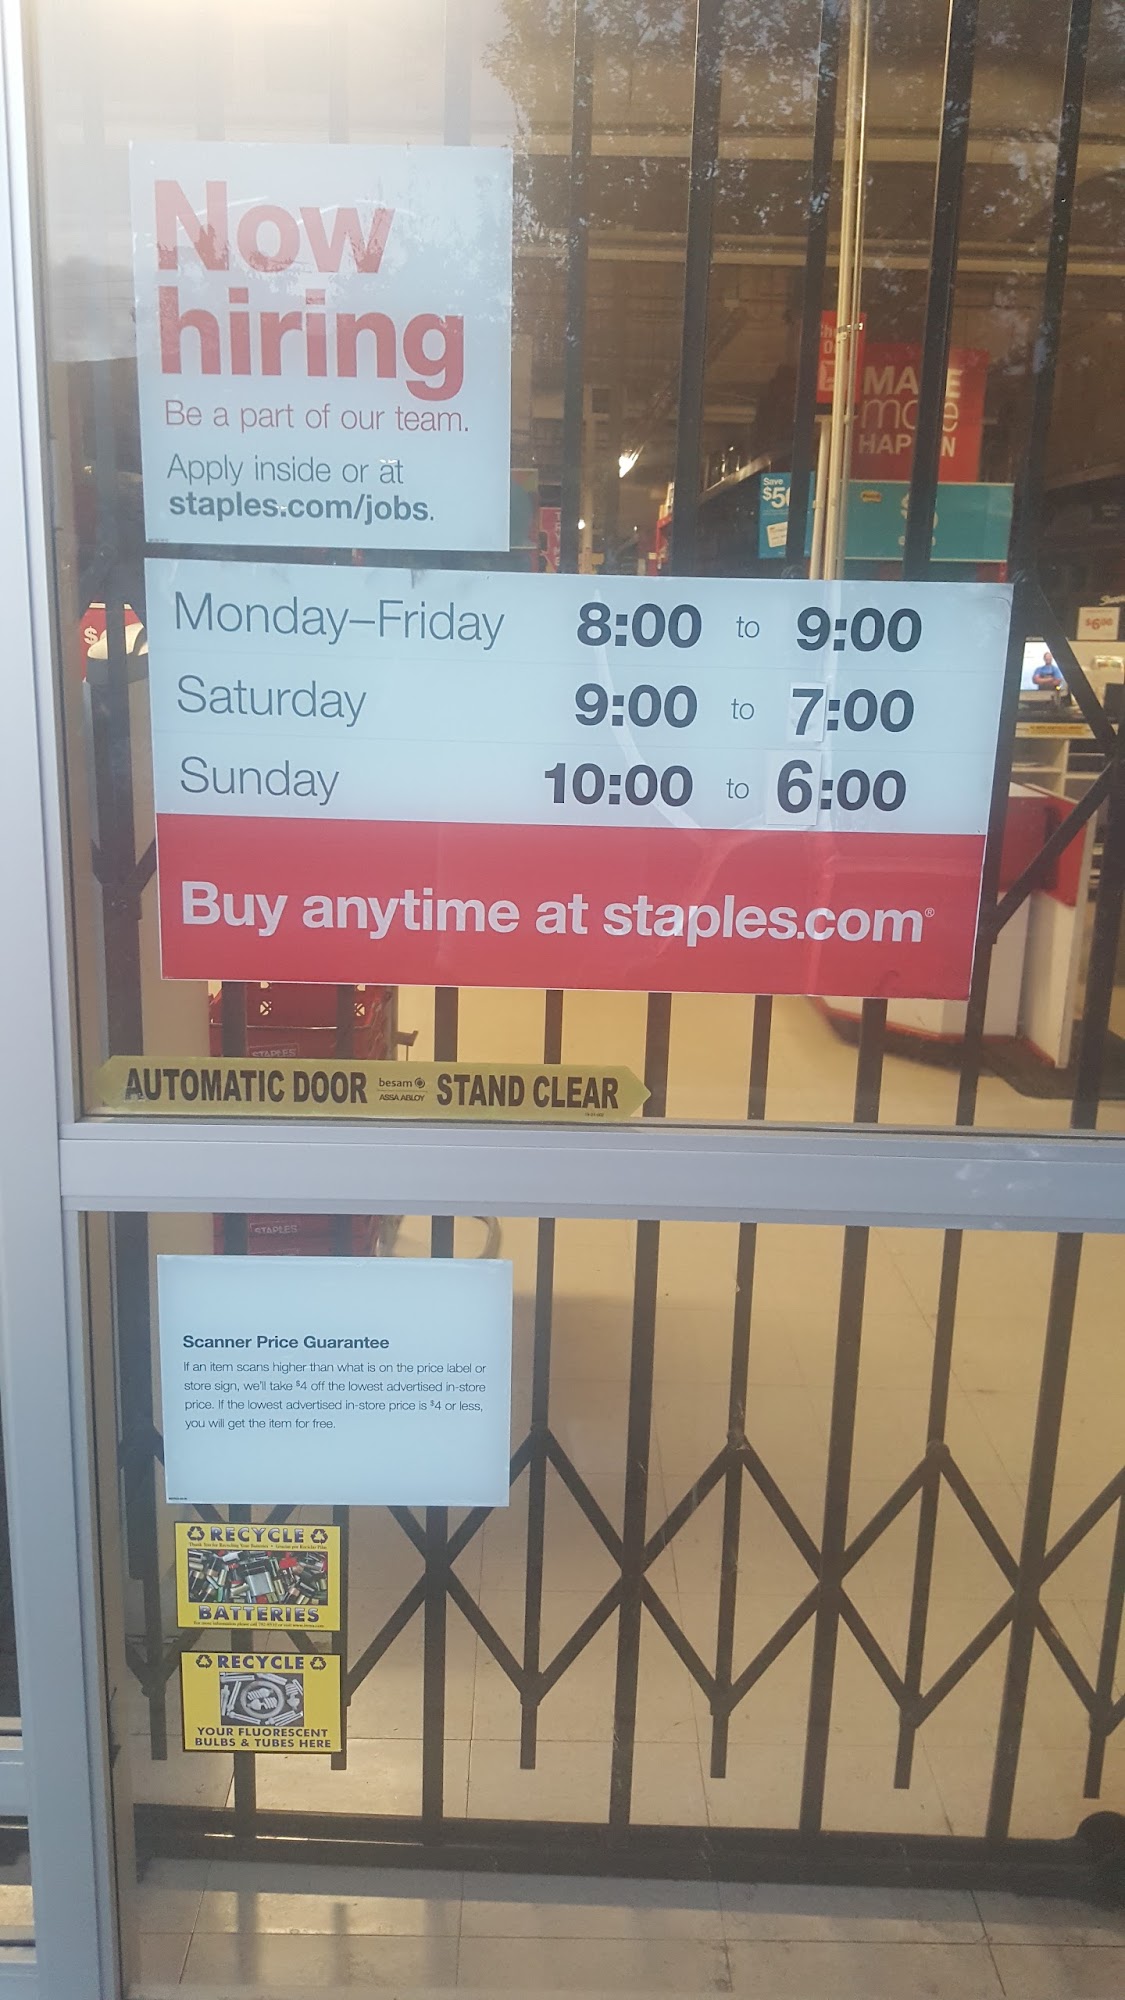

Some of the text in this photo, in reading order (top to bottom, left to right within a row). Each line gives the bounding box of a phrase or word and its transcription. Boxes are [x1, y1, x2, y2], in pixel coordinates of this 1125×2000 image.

[154, 180, 396, 274] Now
[158, 286, 464, 401] hiring
[863, 366, 964, 399] MAE
[165, 400, 469, 433] Be a part of our team.
[860, 399, 960, 433] moe
[858, 434, 957, 458] HAPN
[167, 453, 404, 486] Apply inside or at
[763, 477, 784, 486] Save
[169, 491, 434, 525] staples.com/jobs.
[577, 602, 702, 648] 8:00
[736, 615, 760, 639] to
[796, 607, 922, 652] 9:00
[177, 675, 915, 735] Saturday 9:00 to 7:00
[180, 756, 906, 813] Sunday 10:00 to 6:00
[181, 881, 288, 937] Buy
[302, 888, 520, 940] anytime
[535, 893, 589, 935] at
[125, 1068, 368, 1104] AUTOMATIC DOOR
[379, 1077, 413, 1088] besam
[436, 1074, 619, 1109] STAND CLEAR
[379, 1093, 425, 1102] ASSA ABLOY
[254, 1224, 298, 1234] STAPLES
[183, 1335, 390, 1349] Scanner Price Guarantee
[183, 1361, 486, 1375] If an item scans higher than what is on the price label or
[184, 1380, 486, 1392] store sign, we'll take $4 off the lowest advertised in-store
[184, 1400, 483, 1412] price. If the lowest advertised in-store price is $4 or less,
[185, 1419, 336, 1430] you will get the item for free.
[210, 1527, 304, 1543] RECYCLE
[199, 1605, 319, 1622] BATTERIES
[217, 1655, 305, 1670] RECYCLE
[197, 1727, 329, 1738] YOUR FLUORESCENT
[195, 1738, 331, 1748] BULBS & TUBES HERE
